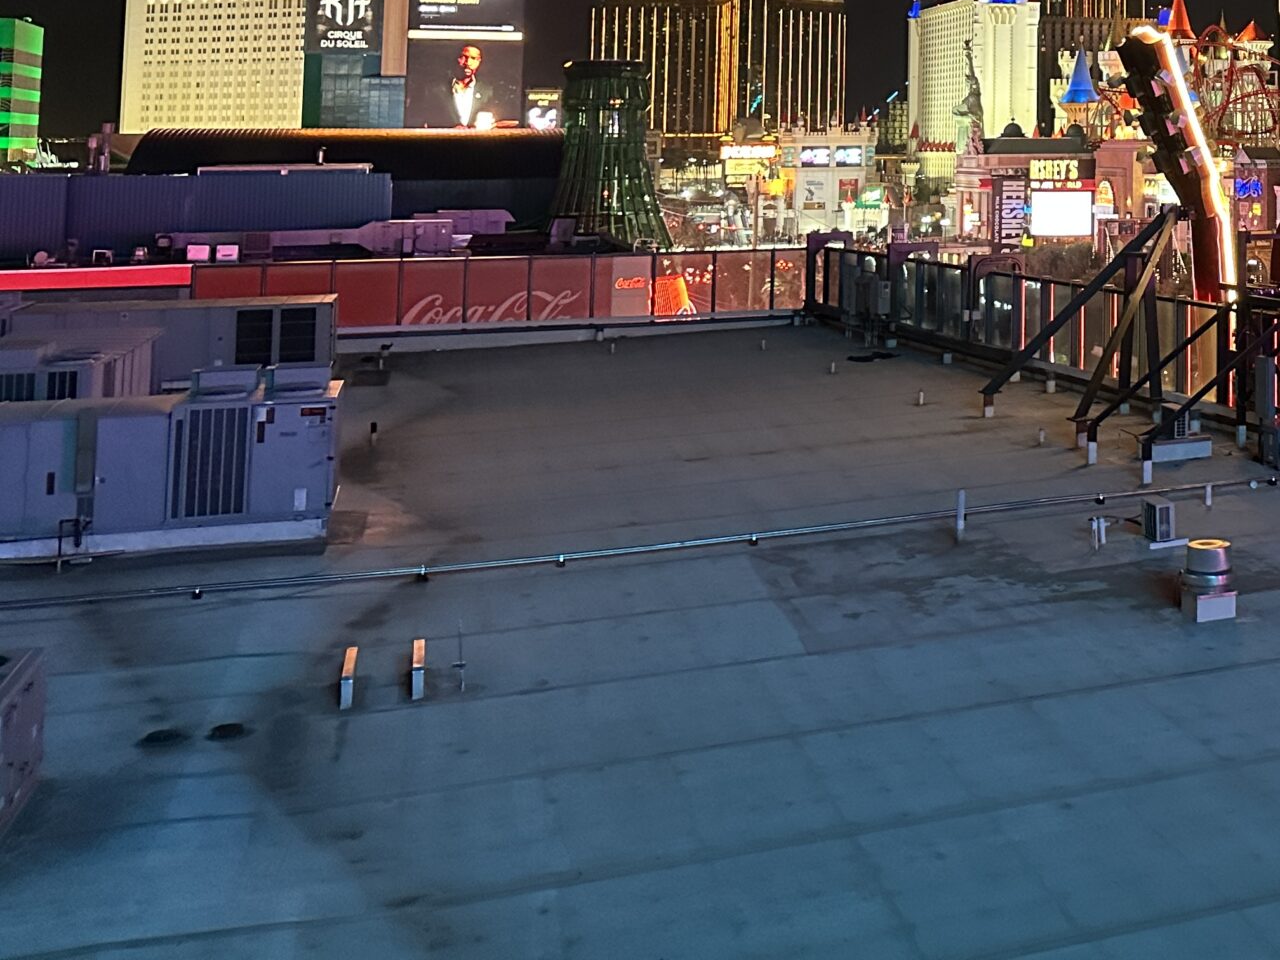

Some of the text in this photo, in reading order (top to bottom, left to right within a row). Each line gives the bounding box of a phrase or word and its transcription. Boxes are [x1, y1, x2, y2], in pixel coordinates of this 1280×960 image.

[327, 31, 363, 40] CIRQUE
[320, 40, 368, 48] DU SOLEIL
